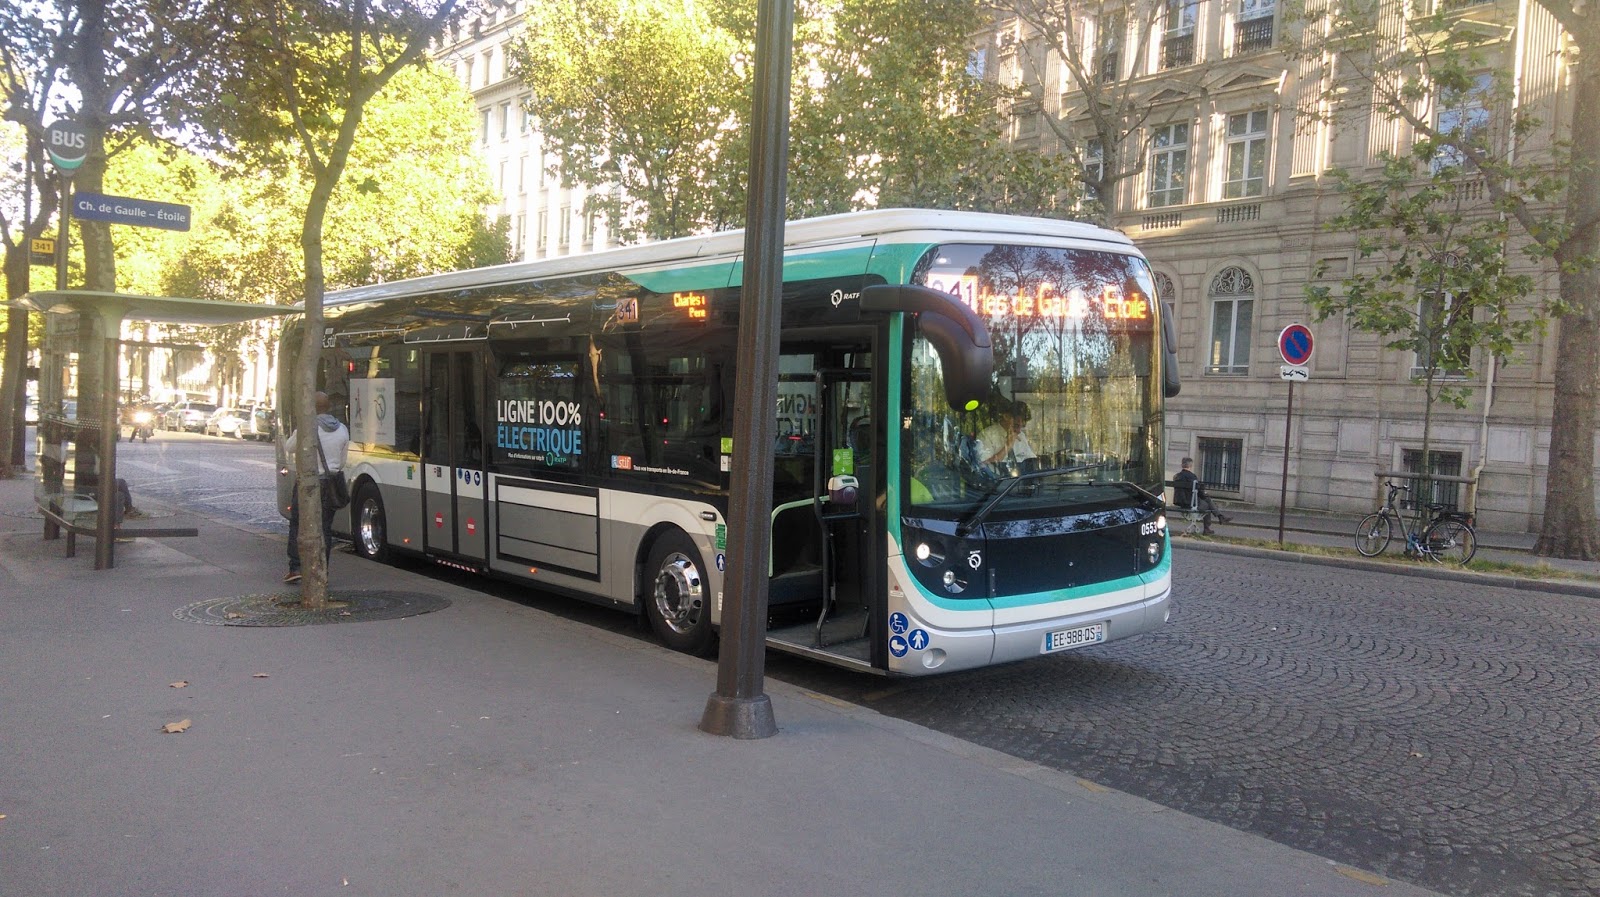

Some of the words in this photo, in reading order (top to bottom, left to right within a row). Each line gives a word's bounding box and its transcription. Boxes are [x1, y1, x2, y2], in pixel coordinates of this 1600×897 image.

[51, 130, 85, 148] BUS
[78, 201, 96, 211] Ch.
[98, 204, 112, 213] de
[114, 205, 147, 217] Gaulle
[157, 208, 186, 222] Étoile
[34, 242, 51, 251] 341
[673, 291, 701, 307] Charles
[1012, 287, 1034, 317] de
[1103, 283, 1147, 319] Etoile
[617, 300, 637, 320] 341
[497, 399, 535, 424] LIGNE
[538, 400, 582, 426] 100%
[497, 422, 582, 458] ÉLECTRIQUE
[618, 456, 631, 469] stif
[1141, 521, 1158, 536] 0553
[1053, 627, 1096, 648] EE-988-QS
